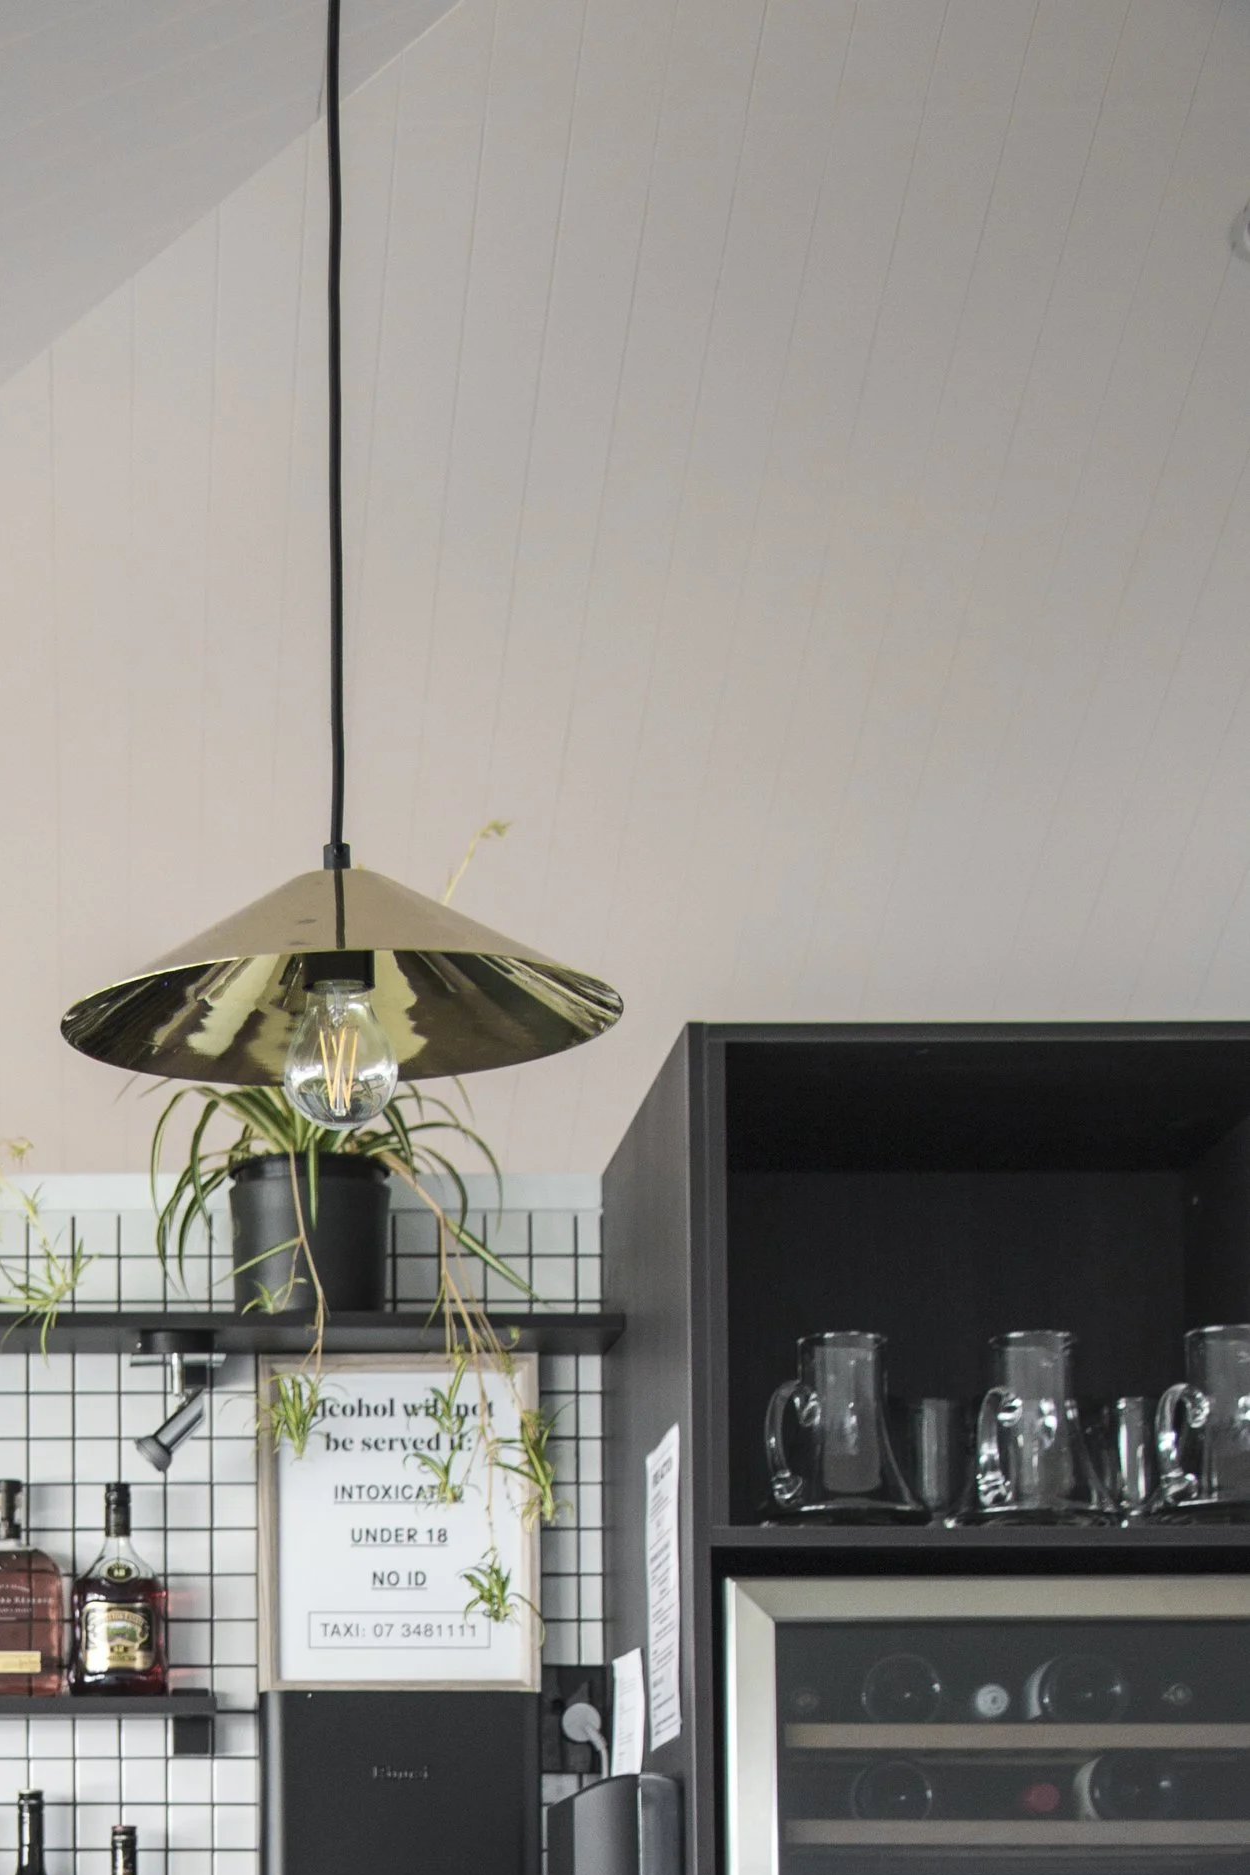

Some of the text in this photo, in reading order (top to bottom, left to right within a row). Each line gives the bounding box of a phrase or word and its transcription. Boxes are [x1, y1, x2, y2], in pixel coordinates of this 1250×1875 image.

[311, 1398, 395, 1418] lcohol
[403, 1399, 444, 1417] wil
[325, 1432, 354, 1451] be
[361, 1432, 441, 1451] served
[334, 1484, 464, 1501] INTOXICAT
[350, 1527, 449, 1544] UNDER 18
[372, 1570, 427, 1587] NO ID
[321, 1622, 477, 1638] TAXI: 07 3481111
